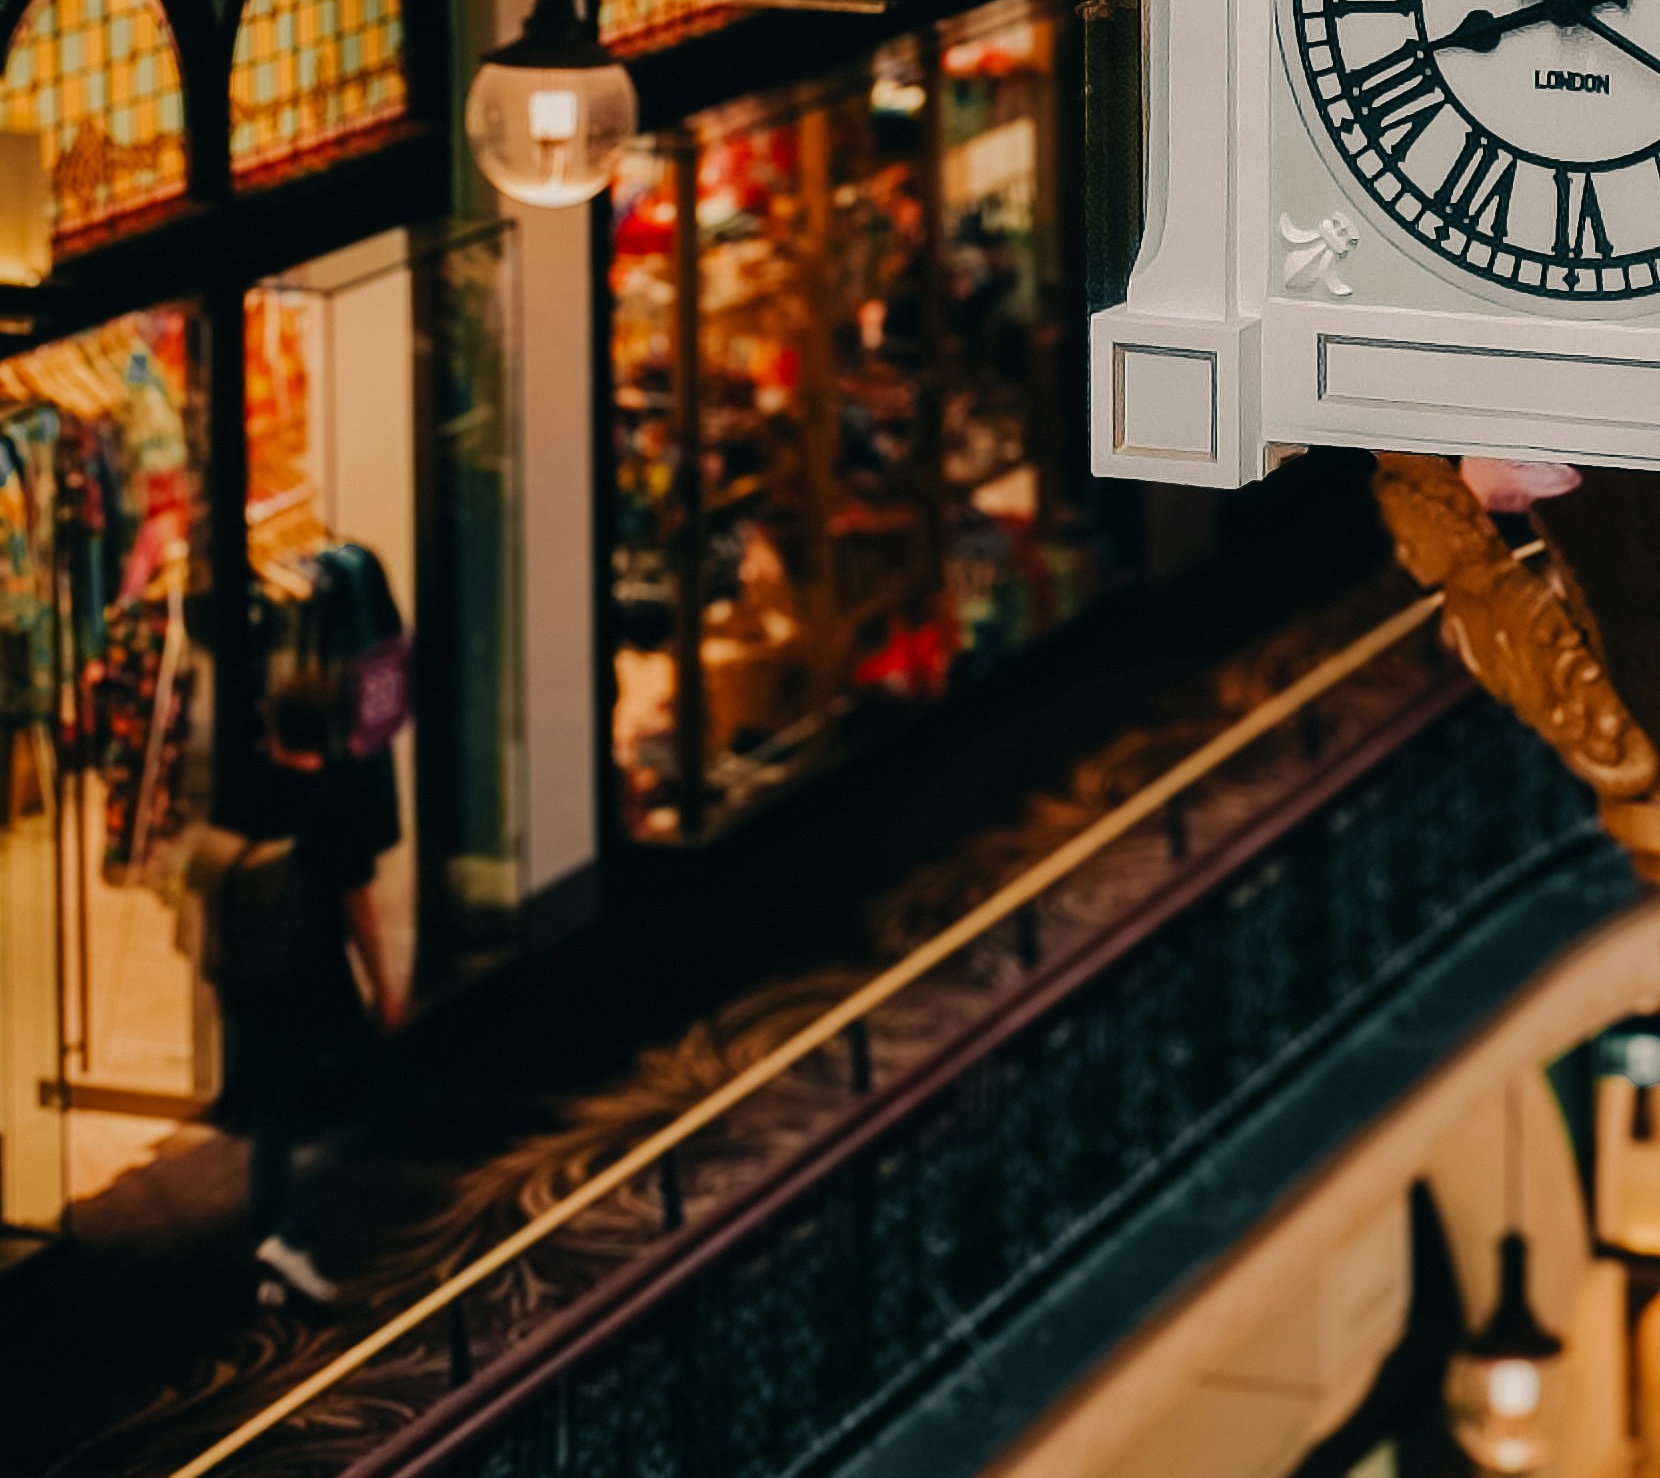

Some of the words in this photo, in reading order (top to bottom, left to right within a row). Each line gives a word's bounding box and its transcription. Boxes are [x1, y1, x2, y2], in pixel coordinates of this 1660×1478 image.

[1344, 38, 1448, 163] VIII
[1534, 69, 1610, 94] LONDON
[1432, 130, 1518, 239] VII
[1551, 168, 1614, 260] VI
